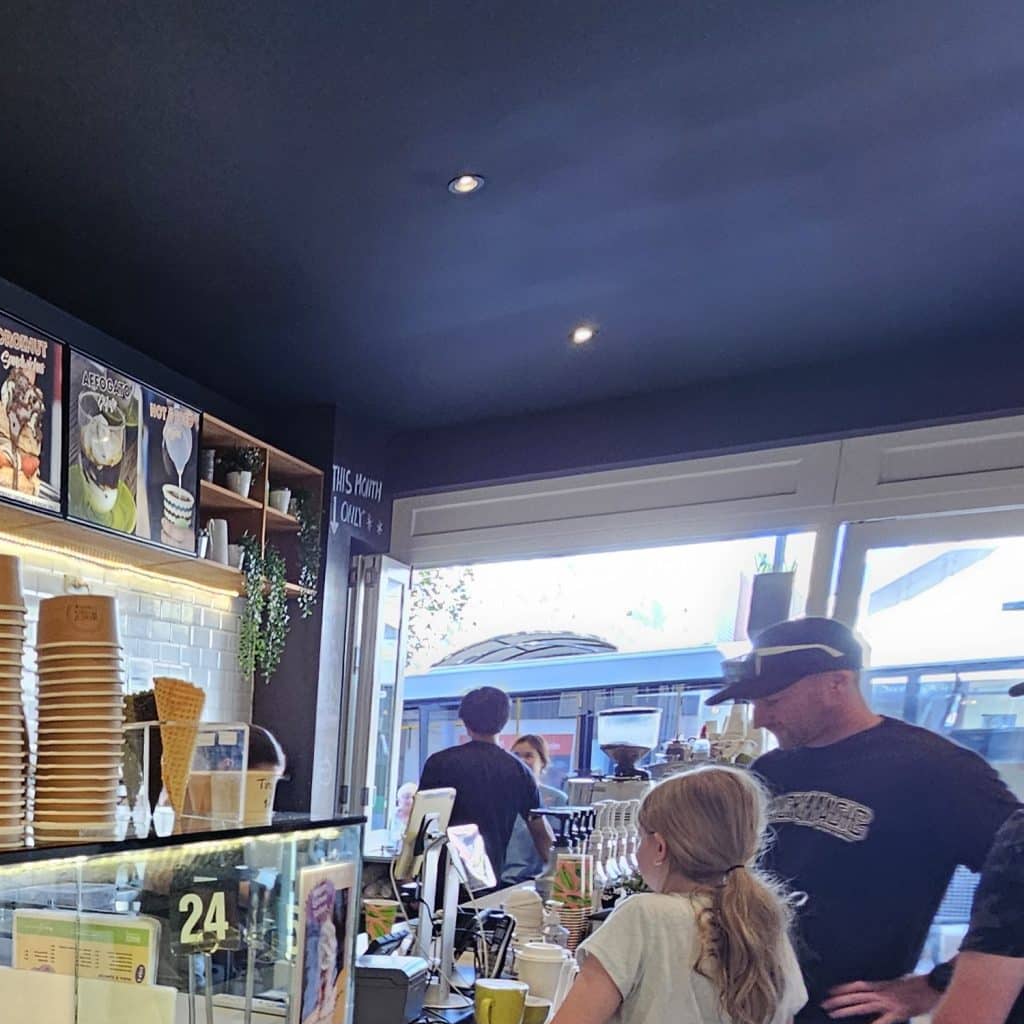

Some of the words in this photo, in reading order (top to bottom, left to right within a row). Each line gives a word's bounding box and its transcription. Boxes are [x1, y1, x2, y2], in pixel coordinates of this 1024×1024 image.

[150, 402, 167, 420] HOT
[333, 464, 352, 494] THIS
[355, 473, 382, 502] MONTH
[341, 501, 365, 528] ONLY
[179, 892, 229, 944] 24
